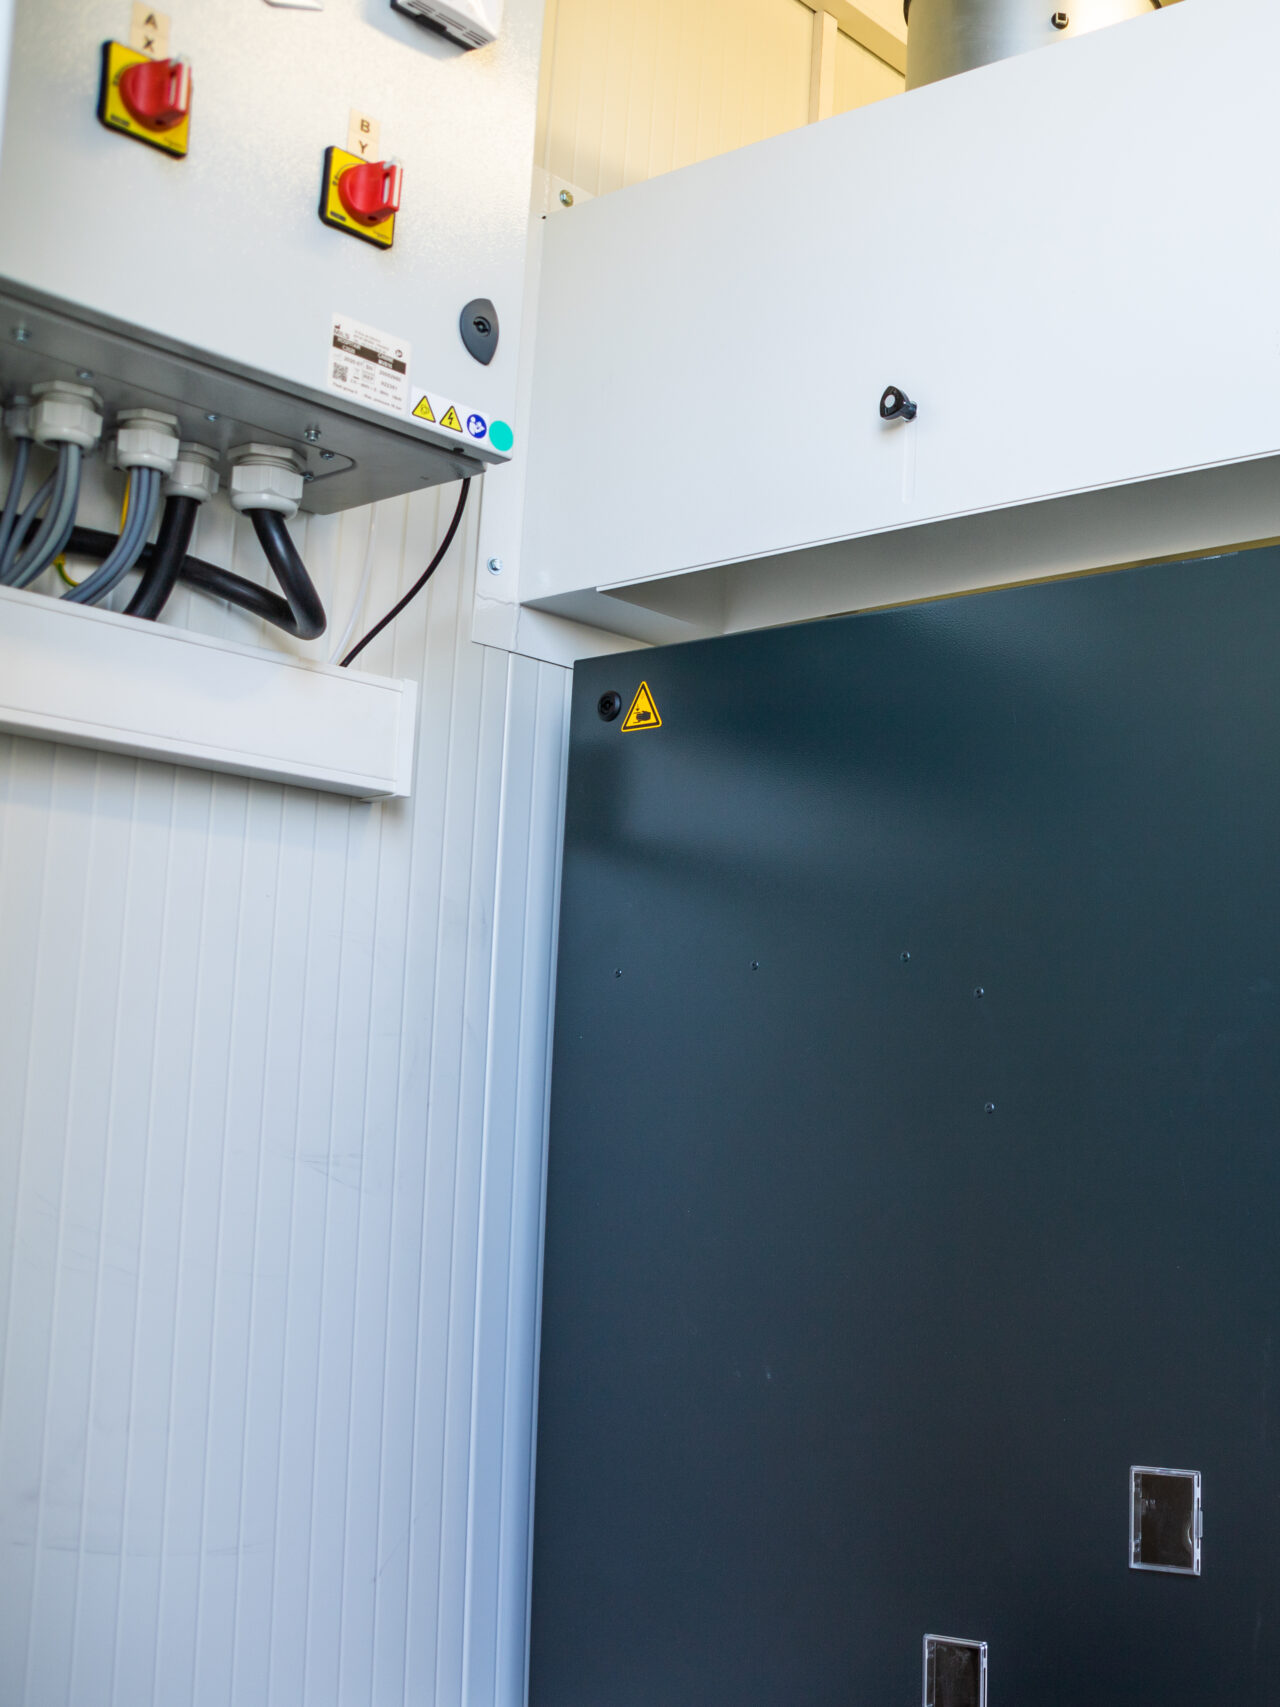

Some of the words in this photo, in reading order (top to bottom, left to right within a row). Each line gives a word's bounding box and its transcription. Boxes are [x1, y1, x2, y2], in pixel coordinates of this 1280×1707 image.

[144, 13, 158, 31] A
[143, 35, 155, 53] X
[360, 118, 371, 134] B
[359, 139, 369, 154] Y
